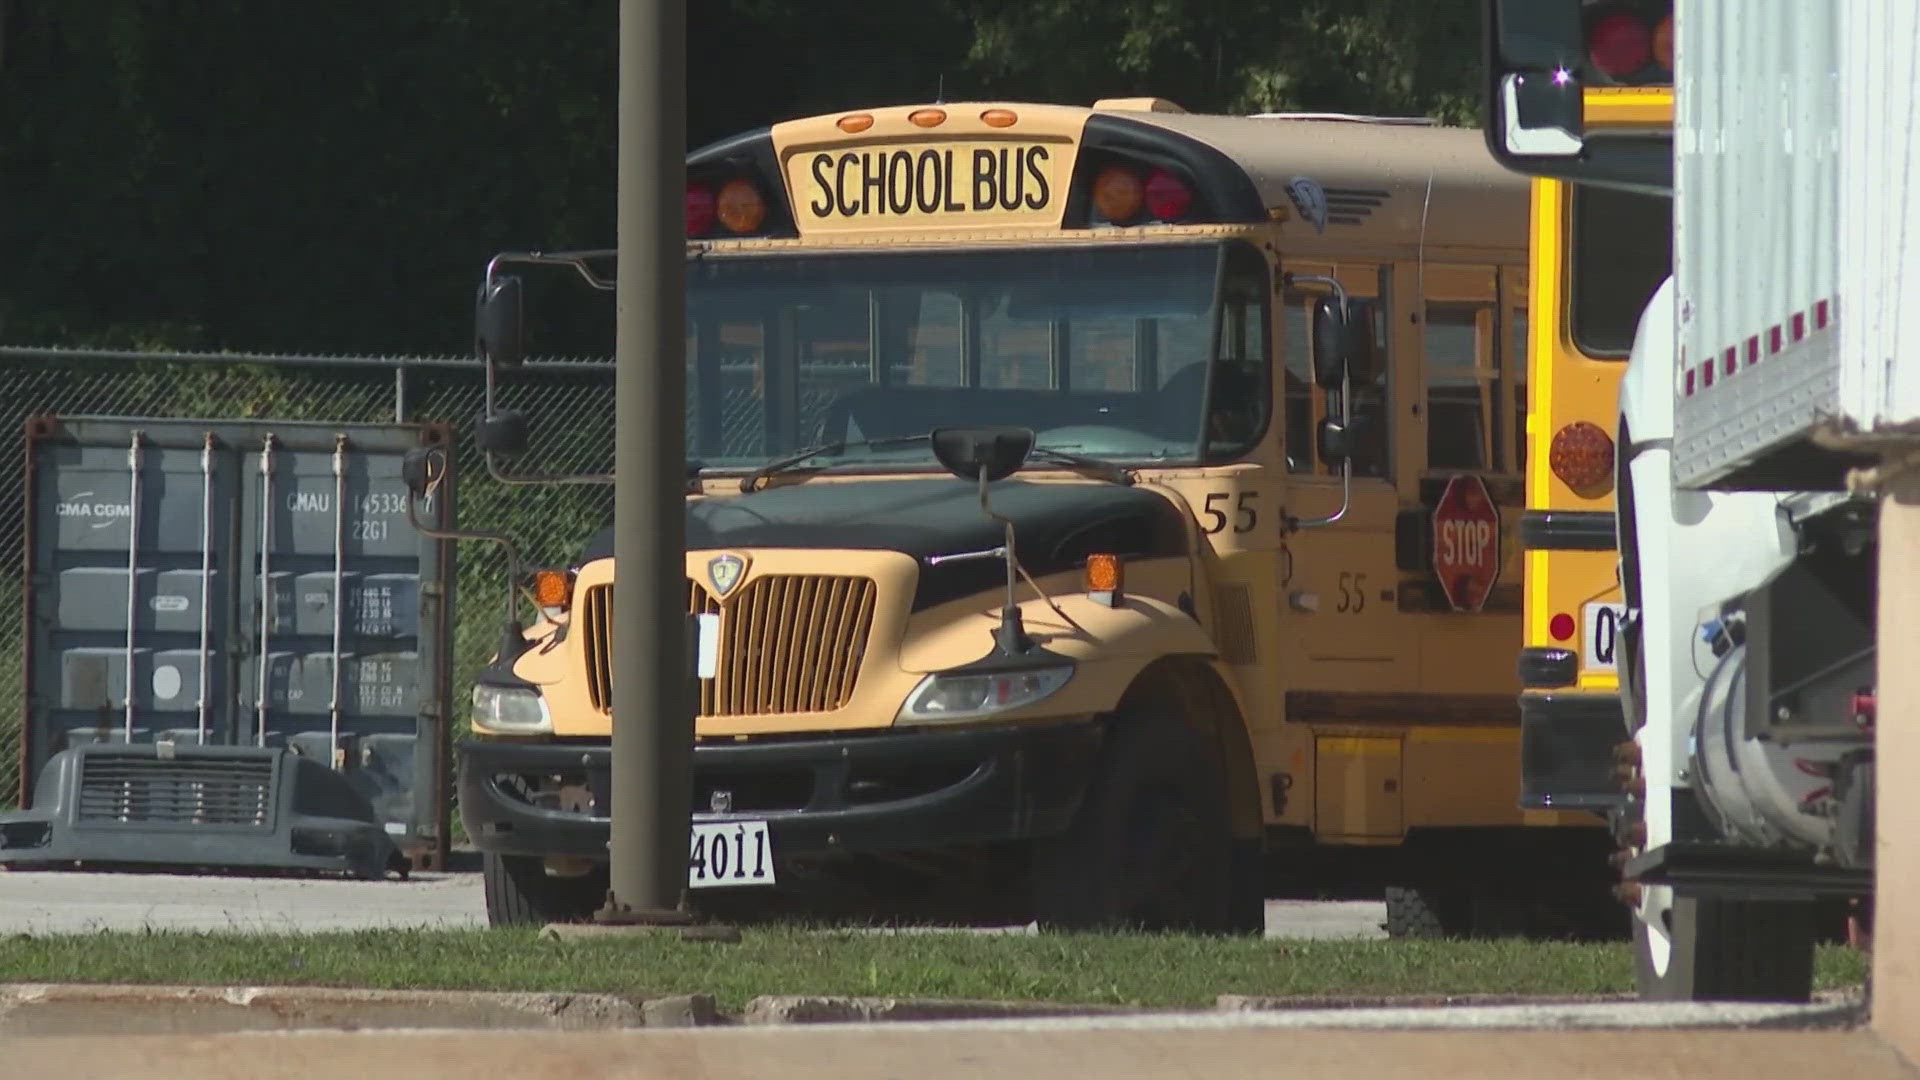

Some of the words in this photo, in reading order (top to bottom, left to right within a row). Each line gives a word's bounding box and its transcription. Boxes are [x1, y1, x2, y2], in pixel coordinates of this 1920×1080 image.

[811, 149, 966, 217] SCHOOL
[972, 145, 1050, 211] BUS
[55, 503, 91, 516] CMA
[94, 504, 130, 517] CGM
[287, 492, 330, 512] CMAU
[354, 493, 407, 514] 145336
[1203, 491, 1259, 534] 55
[353, 520, 388, 540] 22G1
[1443, 519, 1490, 568] STOP
[1337, 571, 1367, 613] 55
[1595, 606, 1615, 664] Q
[689, 830, 765, 880] 4011
